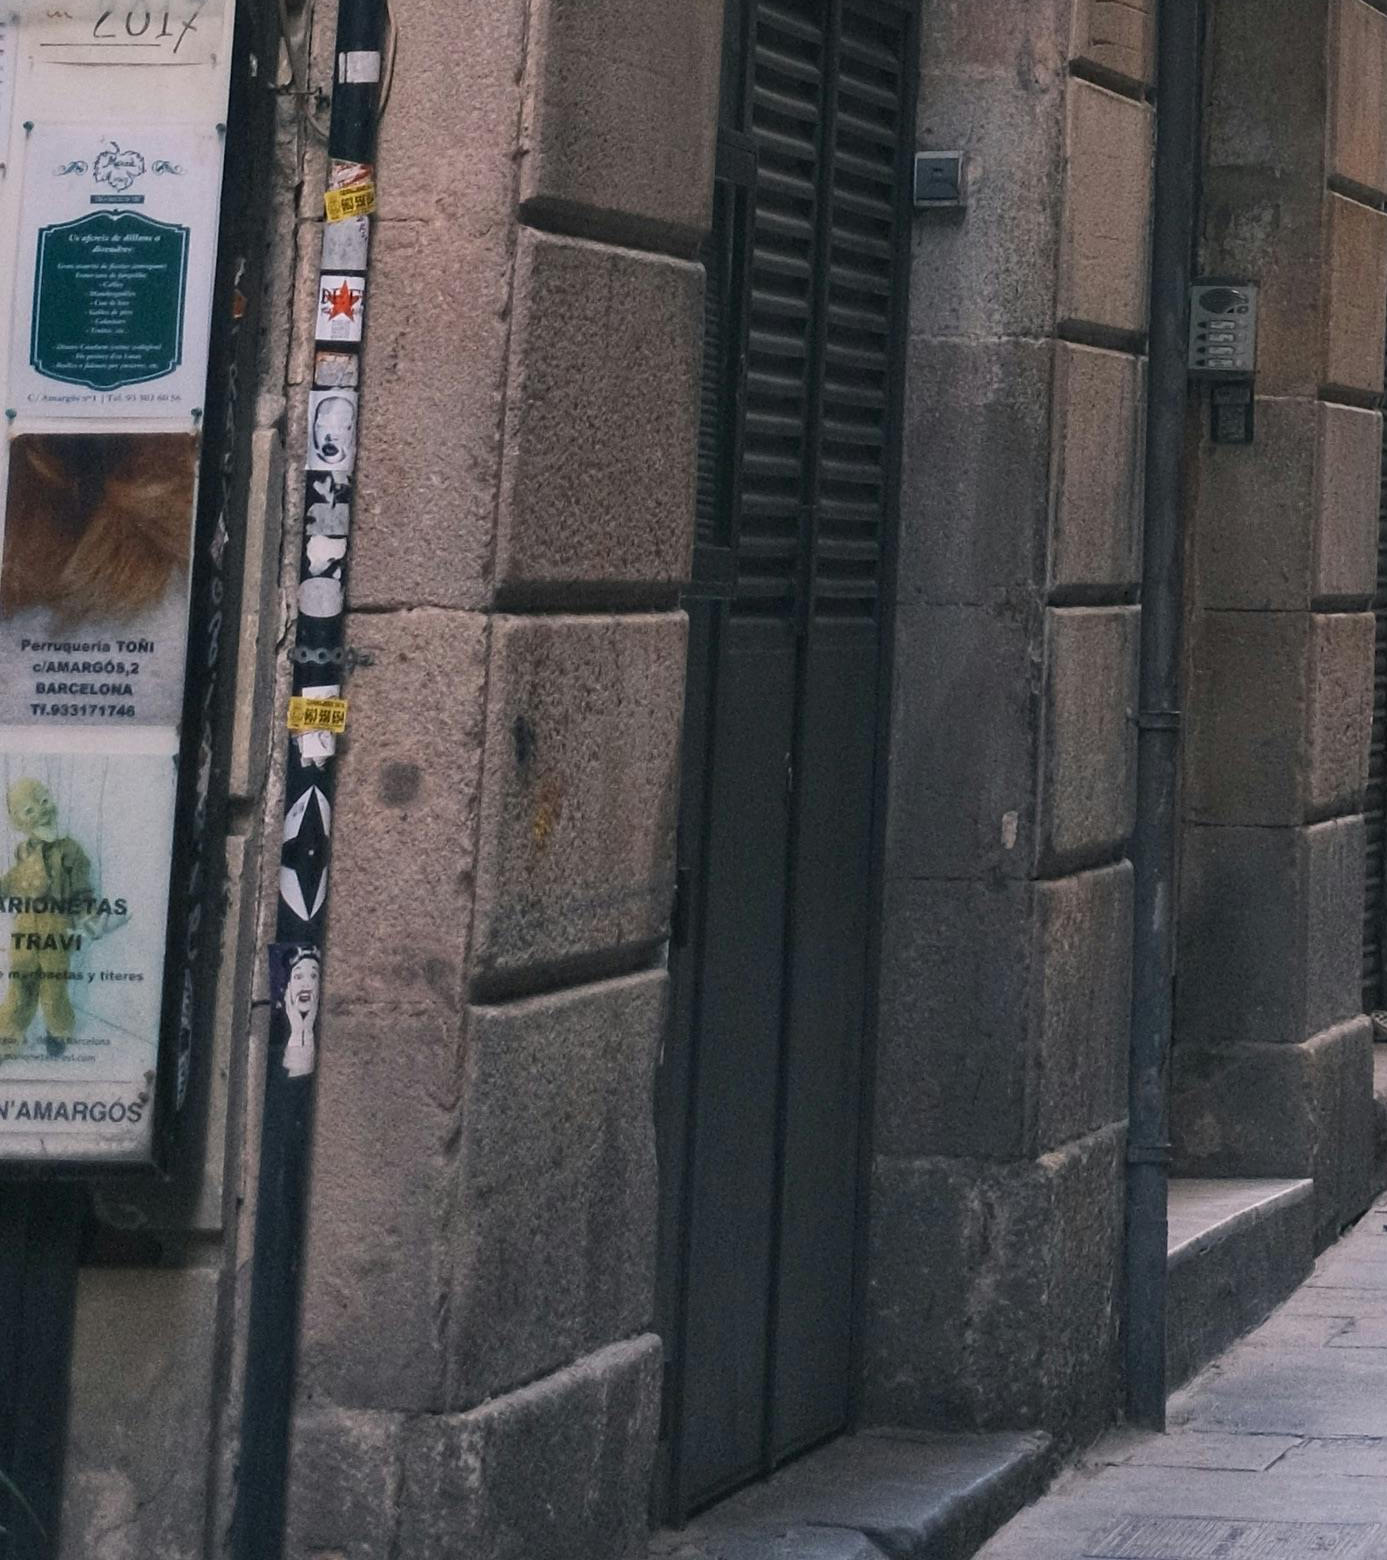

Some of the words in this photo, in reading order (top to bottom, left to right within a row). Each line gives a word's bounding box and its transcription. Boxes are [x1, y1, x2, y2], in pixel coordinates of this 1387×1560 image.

[116, 638, 155, 654] TOÑI
[35, 682, 133, 697] BARCELONA
[11, 932, 82, 952] TRAVI
